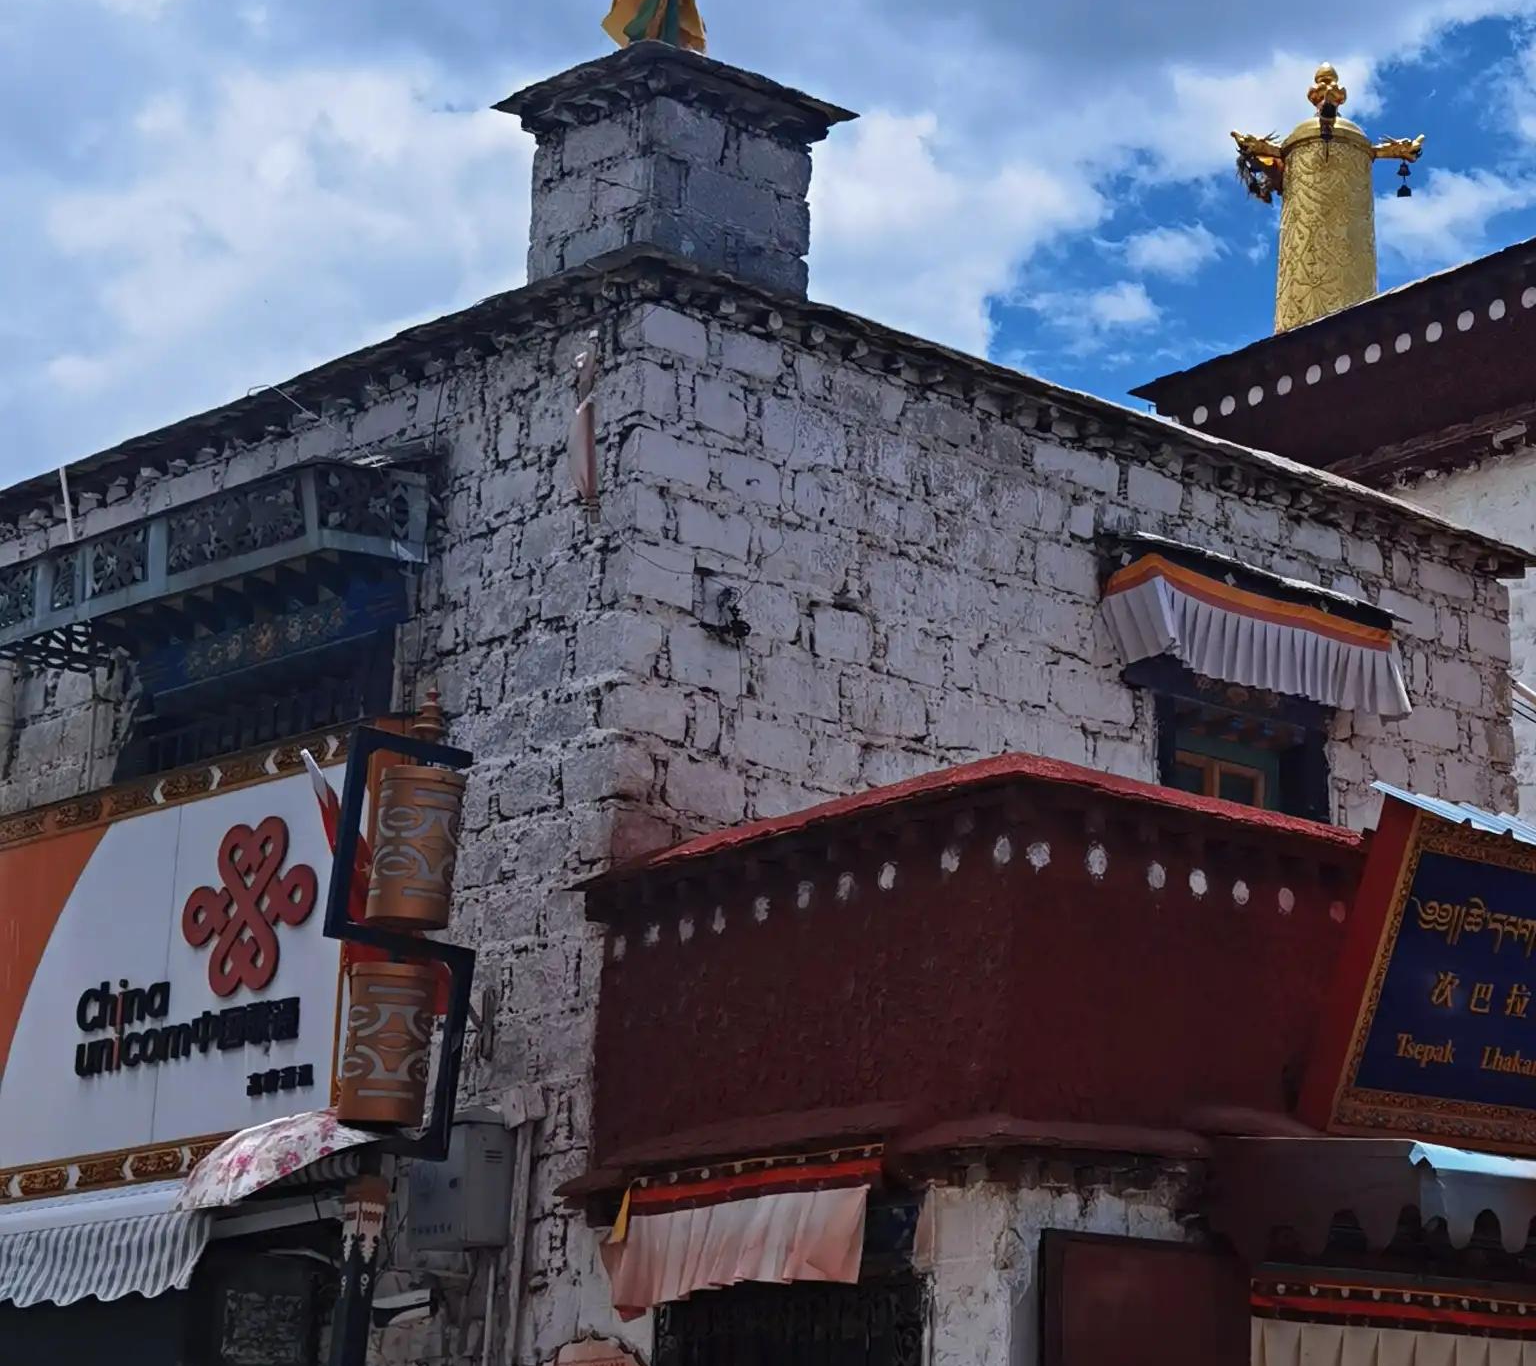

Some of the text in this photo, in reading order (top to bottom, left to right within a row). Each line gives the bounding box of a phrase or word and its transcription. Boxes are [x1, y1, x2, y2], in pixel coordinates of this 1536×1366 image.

[76, 978, 171, 1032] China
[74, 1022, 192, 1077] unicom
[1396, 1033, 1456, 1068] Tsepak
